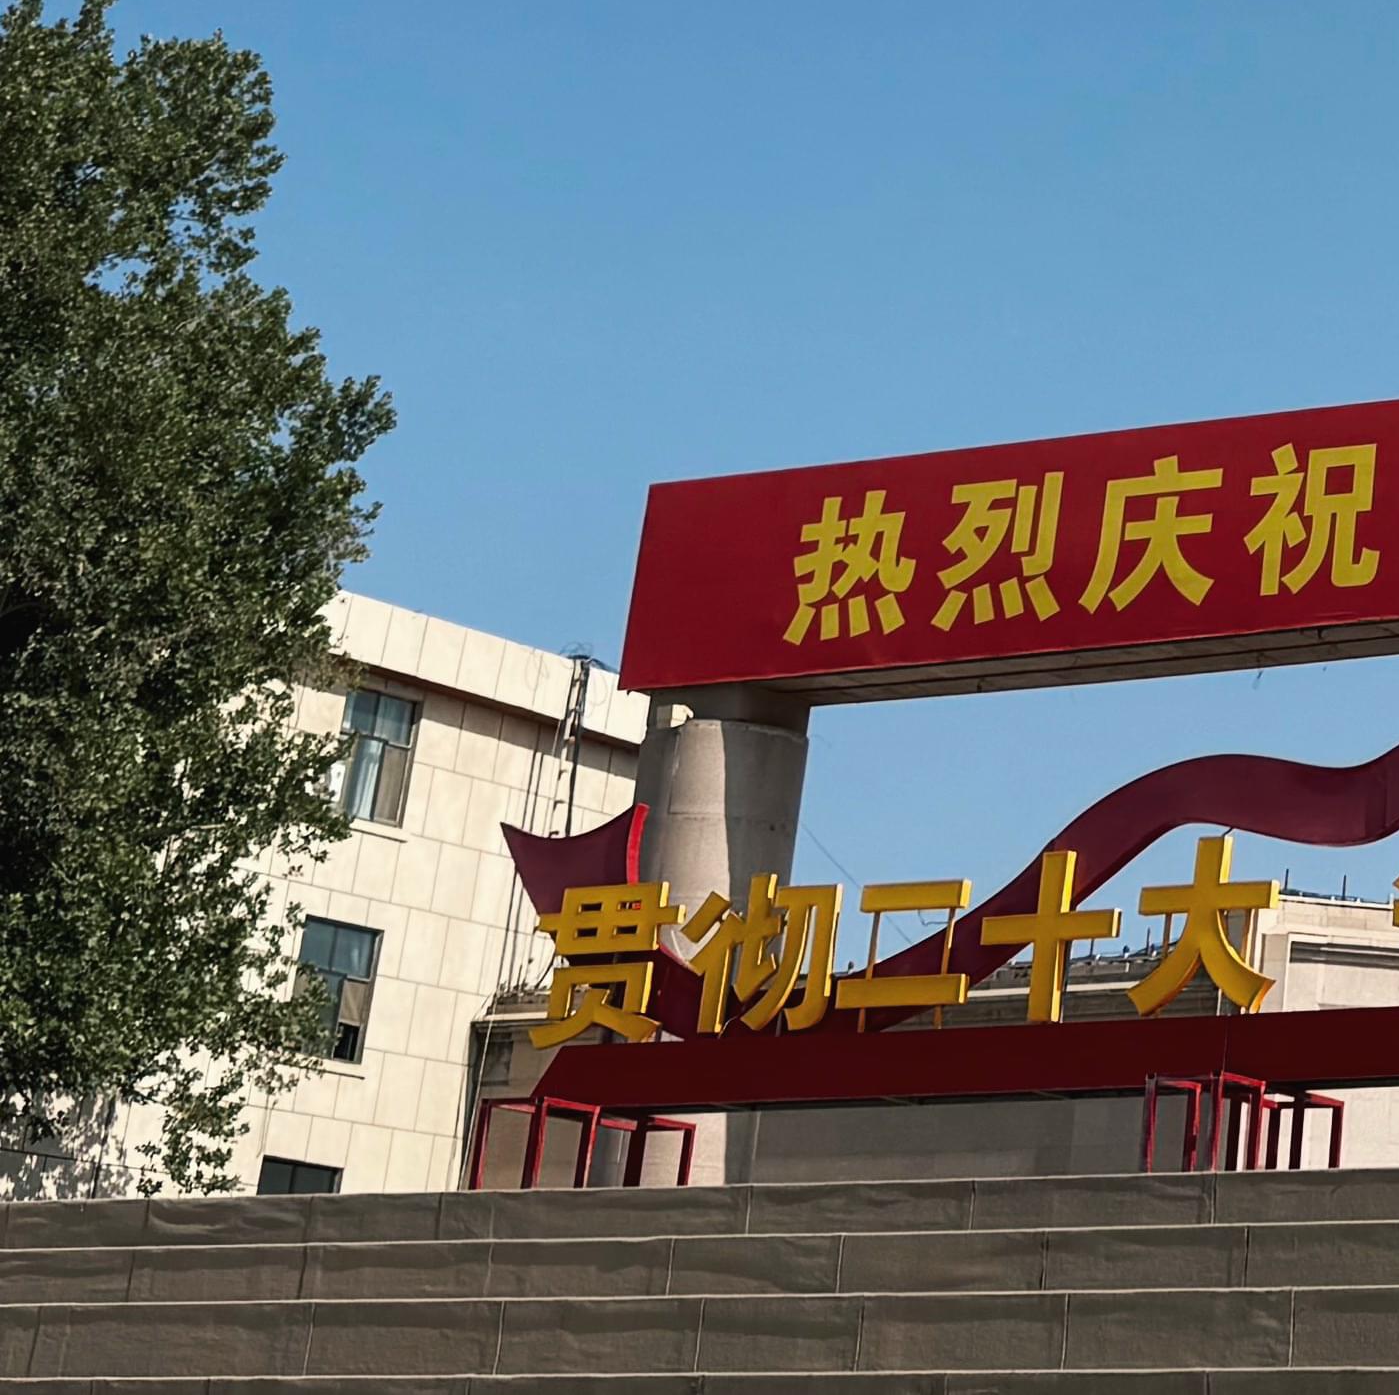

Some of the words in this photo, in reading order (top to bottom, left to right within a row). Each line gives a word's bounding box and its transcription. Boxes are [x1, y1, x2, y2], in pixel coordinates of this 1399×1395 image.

[529, 836, 1279, 1049] 贯彻二十大
